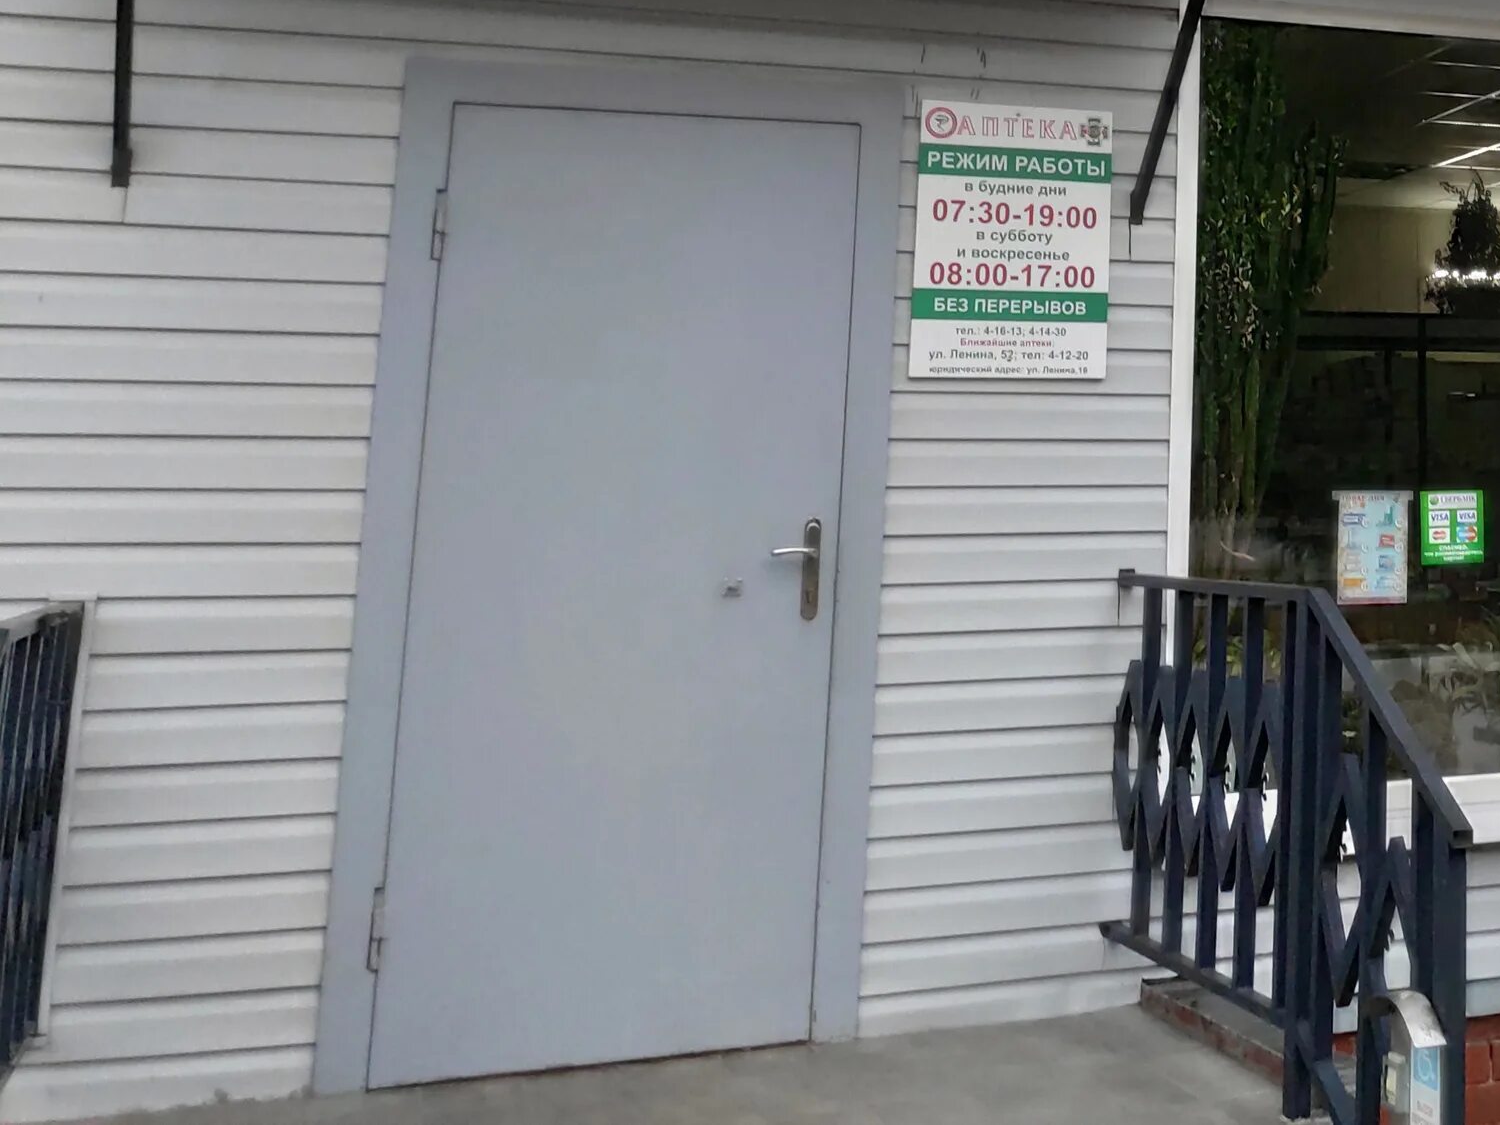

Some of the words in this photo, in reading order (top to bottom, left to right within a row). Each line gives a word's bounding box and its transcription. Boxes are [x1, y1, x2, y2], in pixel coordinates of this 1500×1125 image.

[956, 114, 1078, 141] АПТЕКА
[927, 151, 1008, 172] РЕЖИМ
[1015, 156, 1106, 177] РАБОТЫ
[964, 181, 974, 192] в
[979, 179, 1034, 197] будние
[1038, 183, 1067, 197] дни
[932, 199, 1097, 229] 07:30-19:00
[976, 230, 985, 241] в
[990, 229, 1053, 246] субботу
[956, 248, 966, 259] и
[971, 249, 1070, 262] воскресенье
[929, 262, 1096, 289] 08:00-17:00
[933, 297, 968, 313] БЕЗ
[974, 298, 1087, 316] ПЕРЕРЫВОВ
[960, 338, 1018, 347] Ближайшие
[928, 352, 946, 362] ул.
[950, 349, 998, 361] Ленина,
[1048, 351, 1089, 361] 4-12-20
[1430, 513, 1449, 522] VISA
[1459, 512, 1476, 521] VISA
